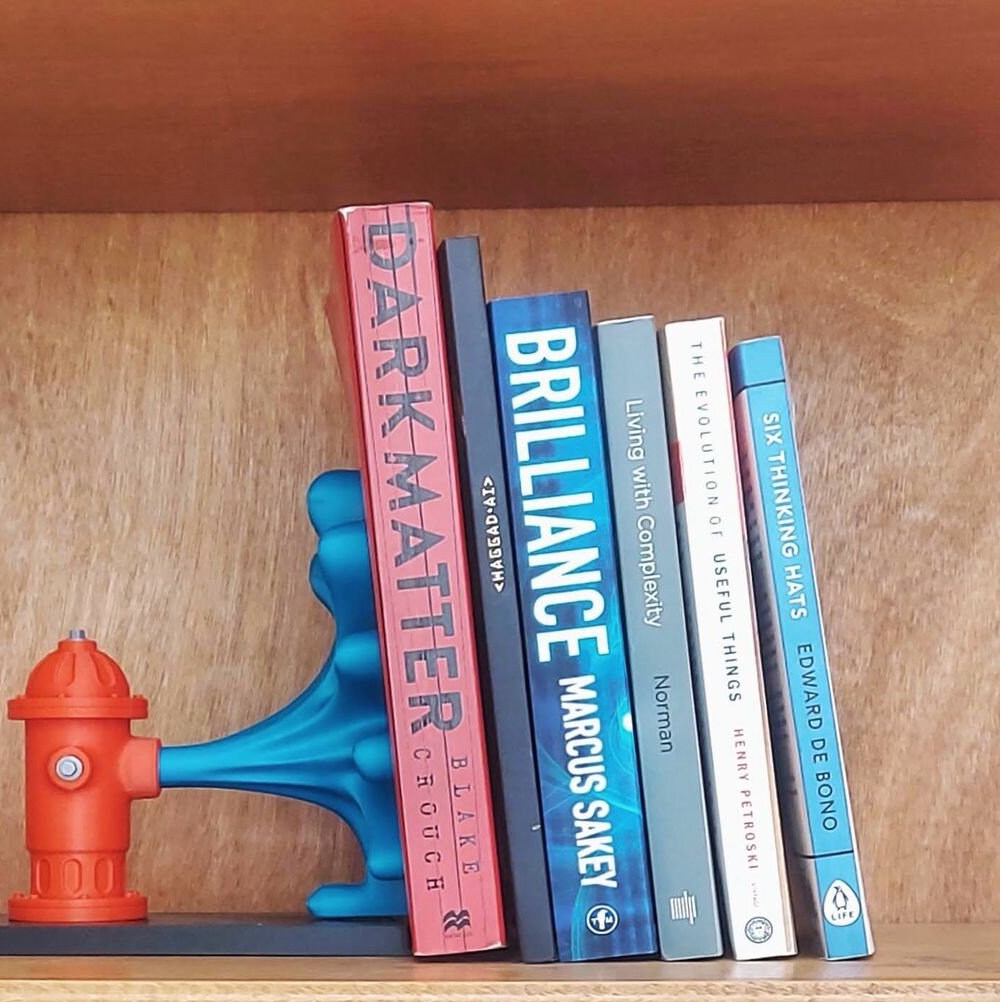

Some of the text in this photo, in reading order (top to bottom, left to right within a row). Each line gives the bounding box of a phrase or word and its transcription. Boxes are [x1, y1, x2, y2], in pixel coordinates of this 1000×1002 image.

[691, 342, 706, 380] THE
[505, 327, 610, 663] BRILLIANCE
[695, 390, 718, 507] EVOLUTION
[625, 399, 662, 628] Living with Complexity
[763, 412, 808, 621] SIX THINKING HATS
[713, 553, 733, 624] USEFUL
[653, 675, 673, 753] Norman
[722, 632, 742, 702] THINGS
[558, 674, 618, 889] MARCUS SAKEY
[733, 728, 749, 781] HENRY
[797, 643, 838, 832] EDWARD DE BONO
[413, 748, 445, 891] CROUCH
[451, 757, 480, 875] BLAKE
[740, 789, 759, 869] PETROSKI
[831, 911, 855, 921] LIFE
